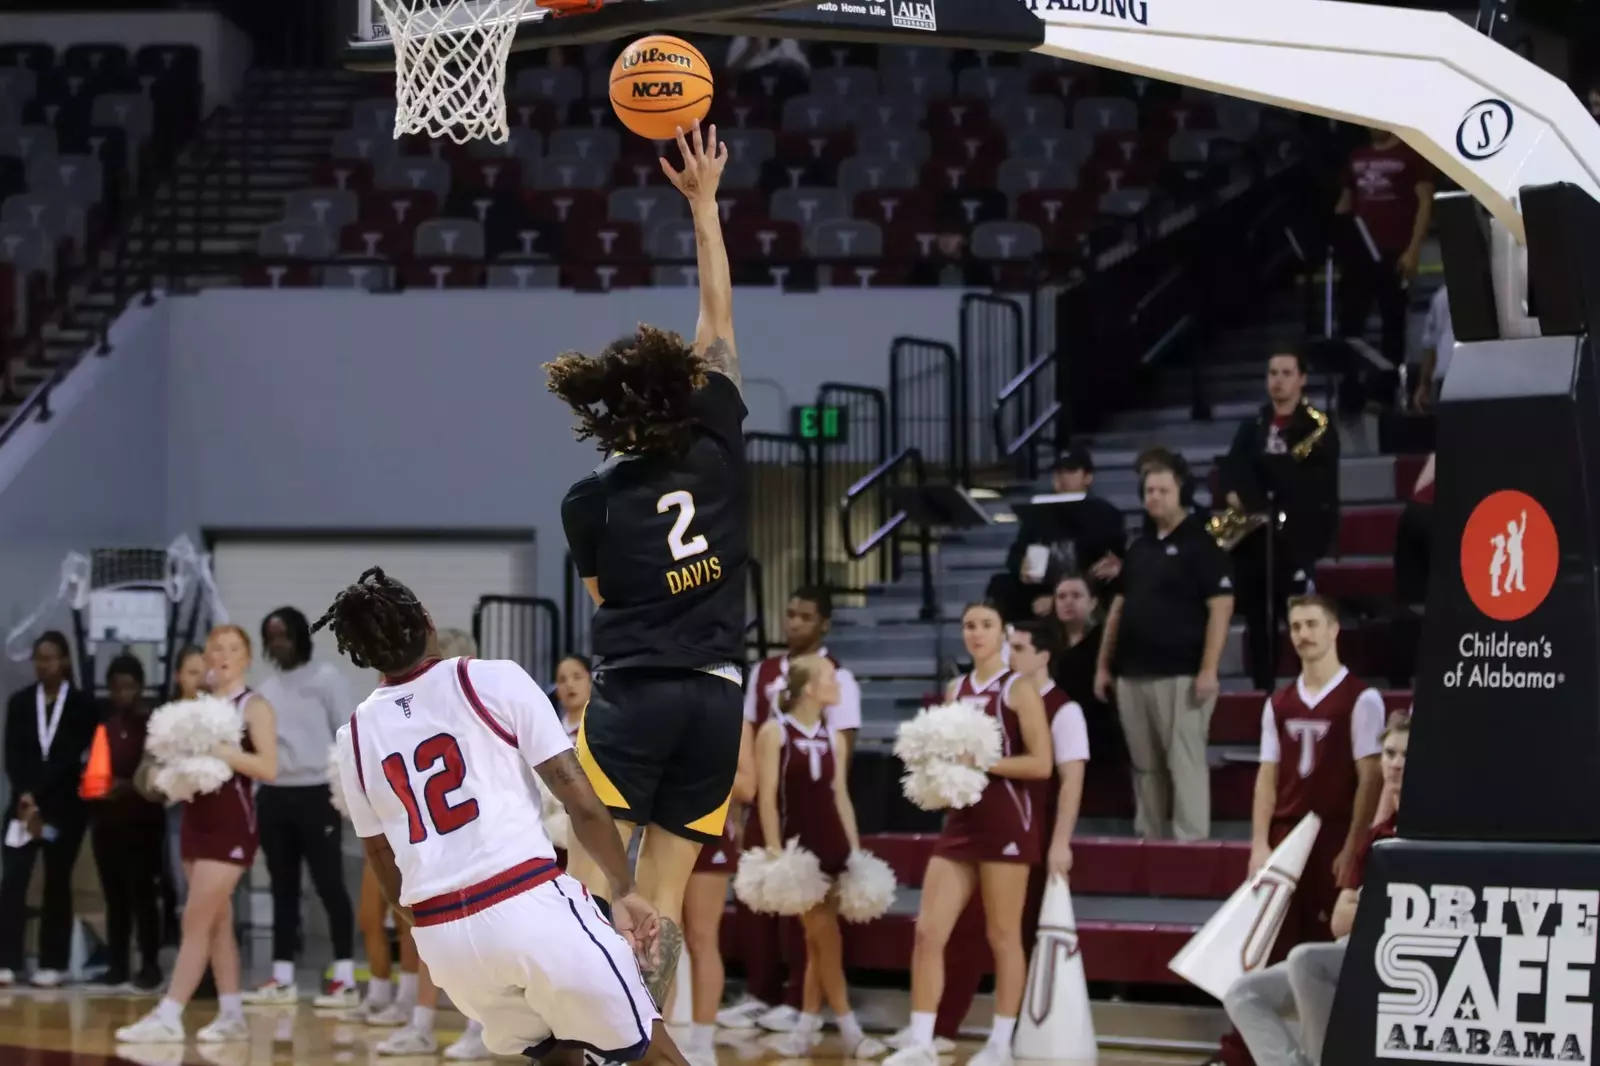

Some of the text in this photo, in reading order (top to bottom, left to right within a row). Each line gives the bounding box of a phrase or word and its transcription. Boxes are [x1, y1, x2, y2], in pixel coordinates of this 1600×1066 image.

[816, 2, 886, 17] Auto Home Life
[898, 1, 934, 20] ALFA
[622, 47, 692, 71] Wilson
[632, 81, 683, 98] NCAA
[656, 490, 709, 561] 2
[666, 556, 722, 595] DAVIS
[1458, 631, 1553, 658] Children's
[1443, 662, 1464, 688] of
[381, 732, 480, 845] 12
[1384, 882, 1600, 938] DRIVE
[1374, 933, 1597, 1025] SAFE
[1383, 1023, 1586, 1062] ALABAMA
